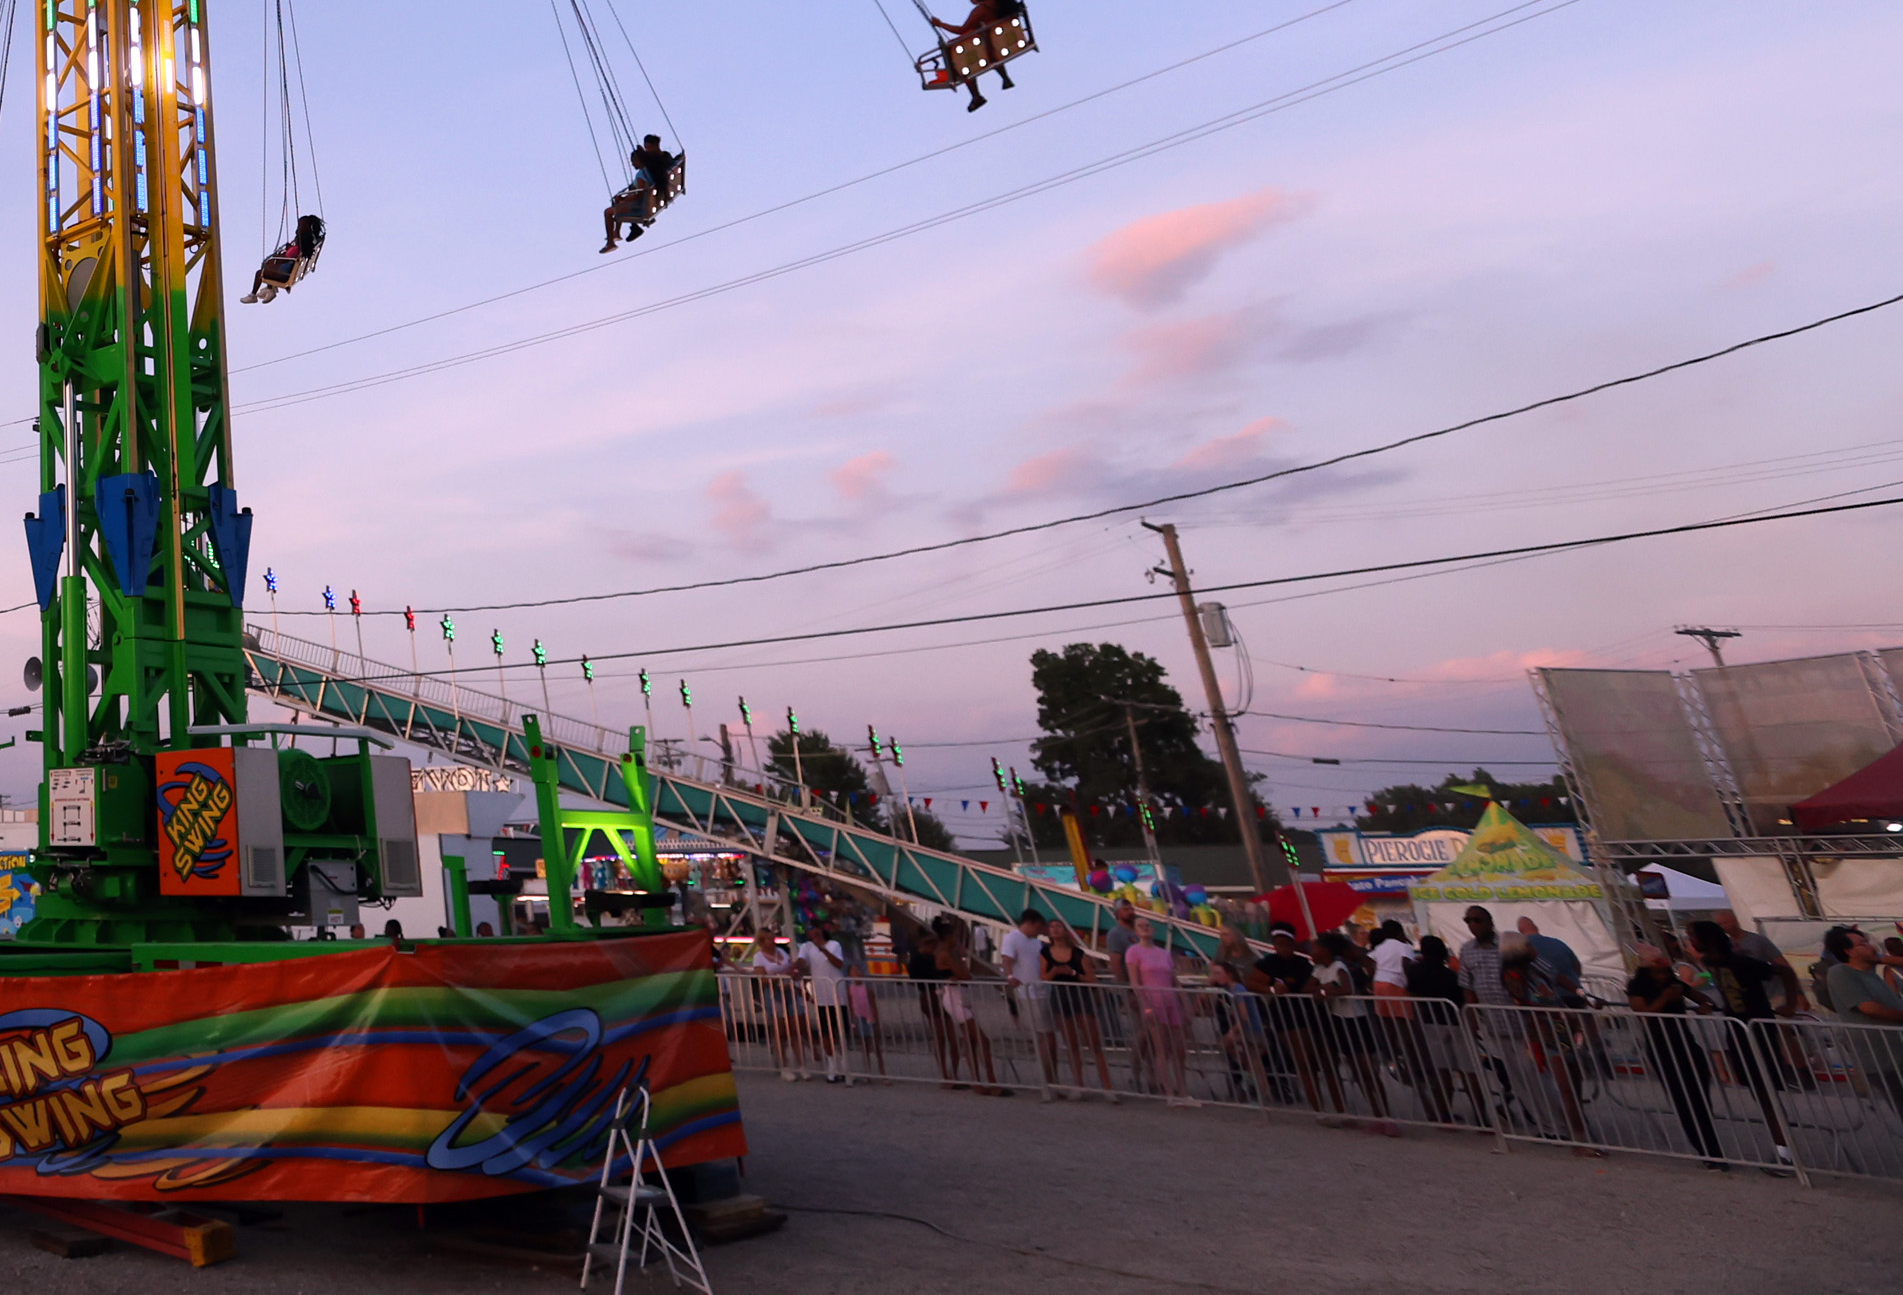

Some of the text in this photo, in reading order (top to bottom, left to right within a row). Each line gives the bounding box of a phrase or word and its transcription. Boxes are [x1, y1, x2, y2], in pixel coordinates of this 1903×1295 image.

[166, 775, 209, 846] KING
[174, 782, 231, 877] SWING
[1365, 838, 1451, 863] PIEROGIE
[1410, 884, 1603, 900] ICE COLD LEMONADE
